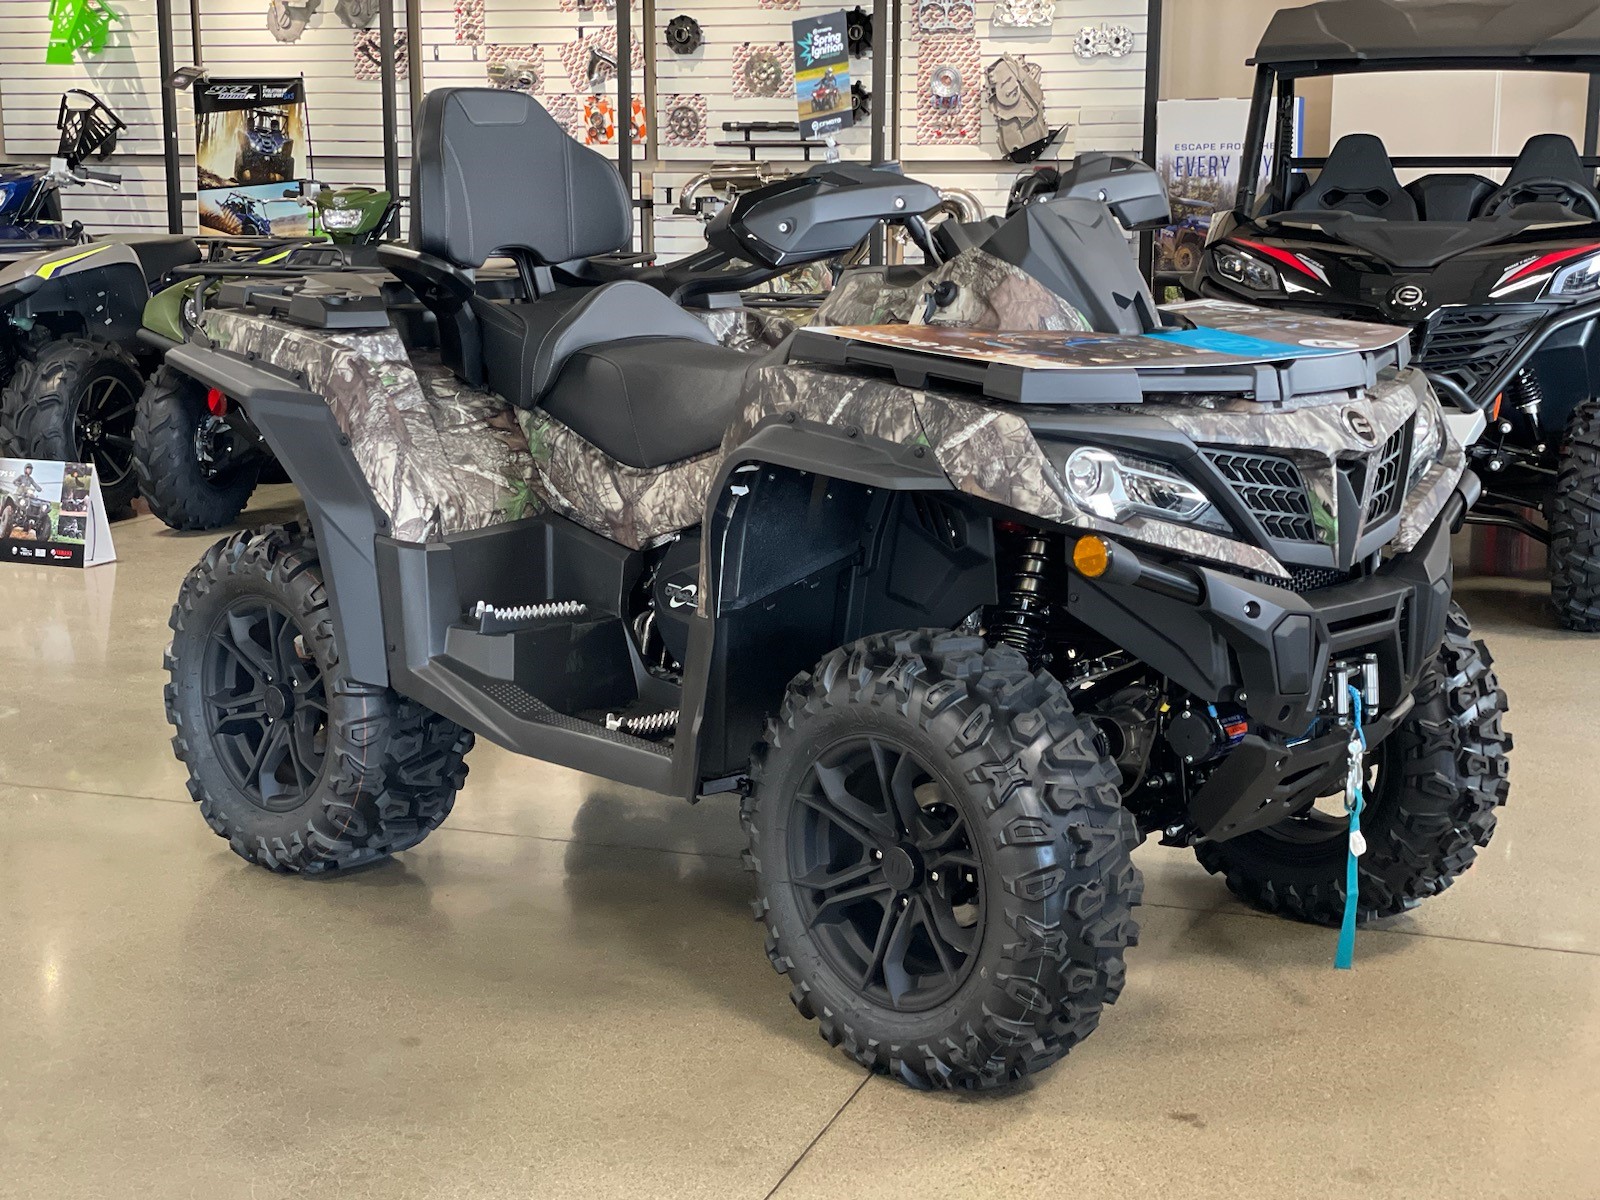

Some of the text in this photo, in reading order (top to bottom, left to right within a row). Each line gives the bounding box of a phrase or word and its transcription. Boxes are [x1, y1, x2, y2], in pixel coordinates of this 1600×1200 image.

[813, 32, 841, 46] Spring
[811, 43, 843, 59] Ignition
[1174, 143, 1215, 151] ESCAPE
[1220, 142, 1245, 150] FRO
[1175, 155, 1230, 177] EVERY
